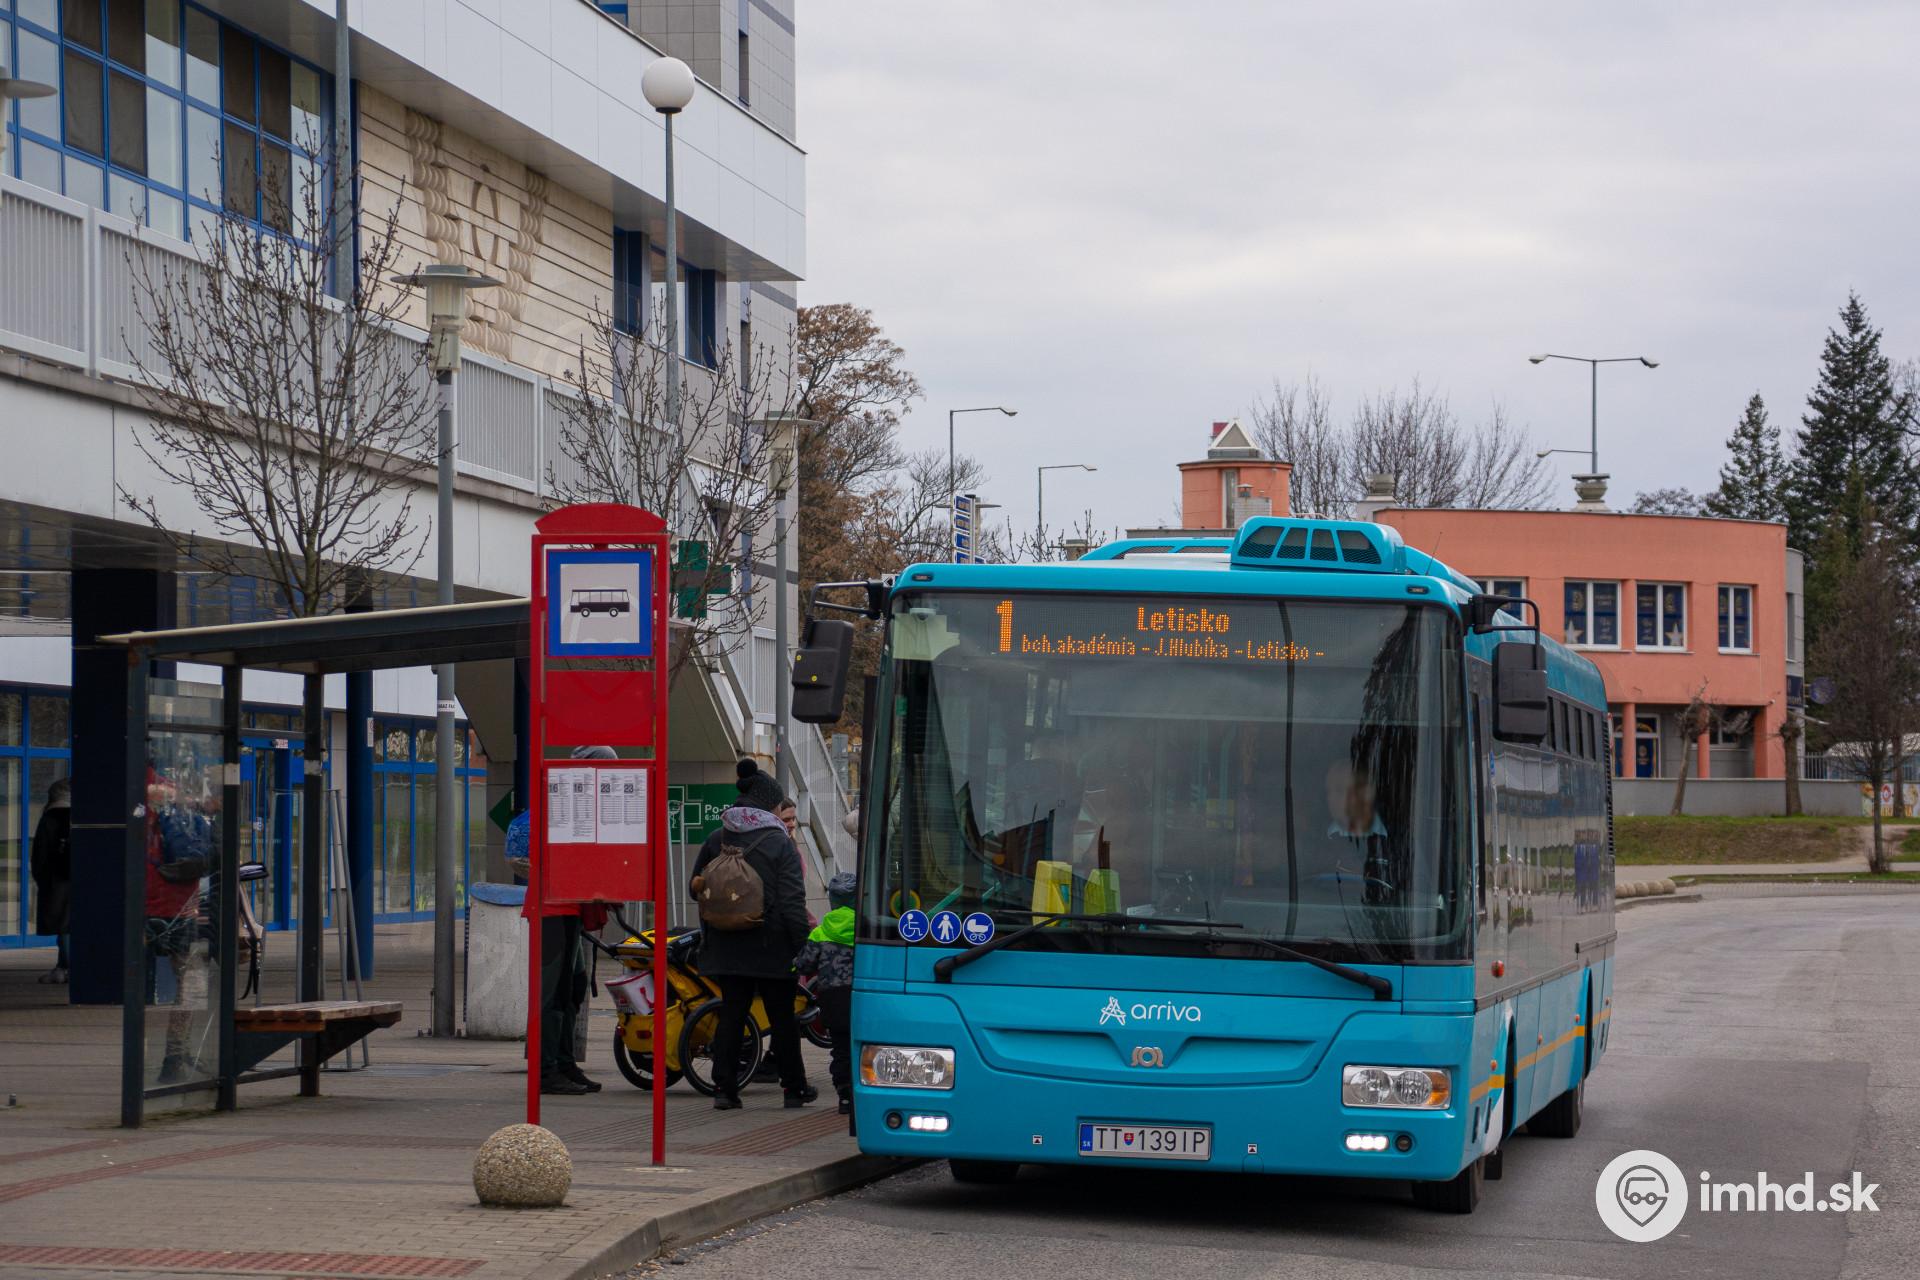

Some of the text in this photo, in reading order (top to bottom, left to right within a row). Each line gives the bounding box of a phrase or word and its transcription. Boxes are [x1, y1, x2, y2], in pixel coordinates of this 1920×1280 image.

[996, 600, 1013, 652] 1
[1137, 608, 1229, 633] Letisko
[1022, 634, 1135, 655] bch.akadémia
[601, 783, 611, 793] 23
[624, 784, 634, 794] 23
[1131, 1001, 1201, 1021] arriva
[1096, 1128, 1122, 1150] TT
